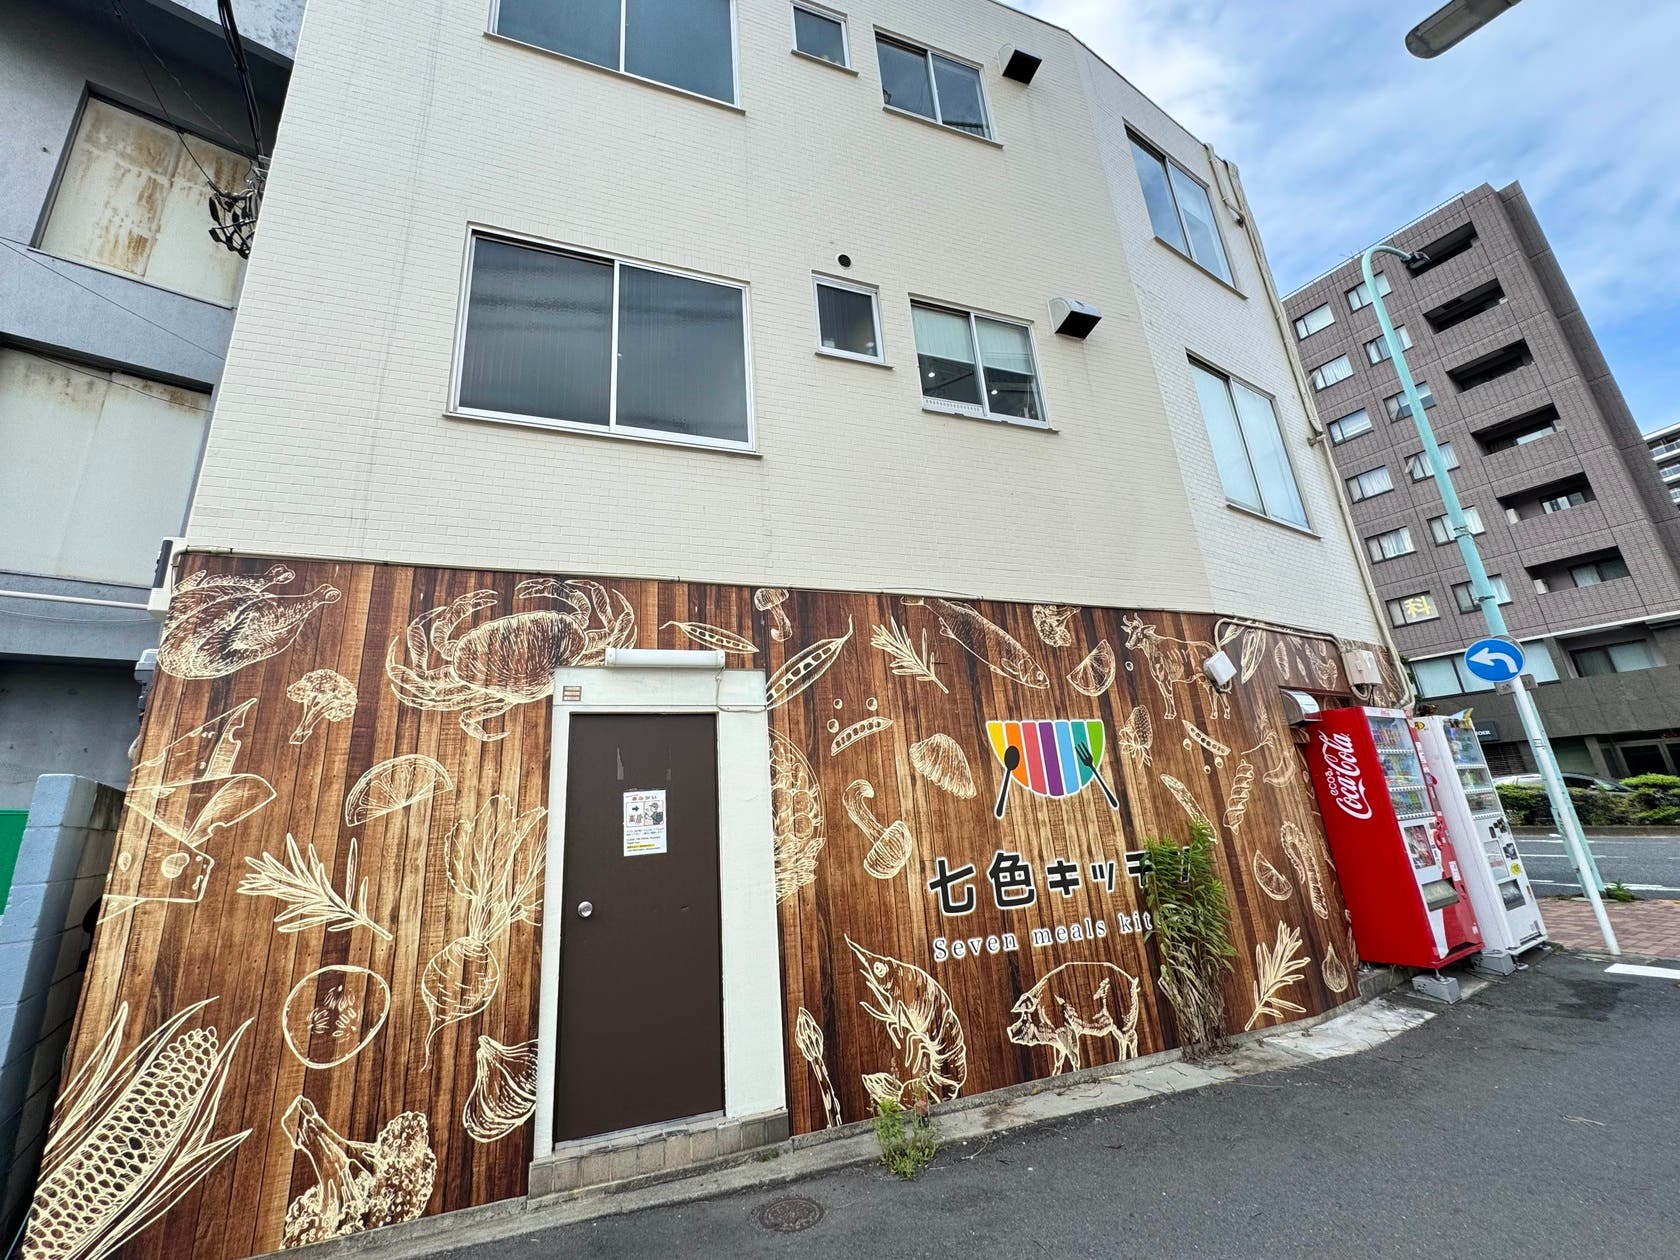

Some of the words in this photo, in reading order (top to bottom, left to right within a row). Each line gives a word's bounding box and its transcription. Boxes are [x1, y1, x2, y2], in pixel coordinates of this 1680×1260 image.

[1403, 595, 1431, 618] 科
[933, 936, 1018, 962] Seven
[1032, 917, 1107, 947] meals
